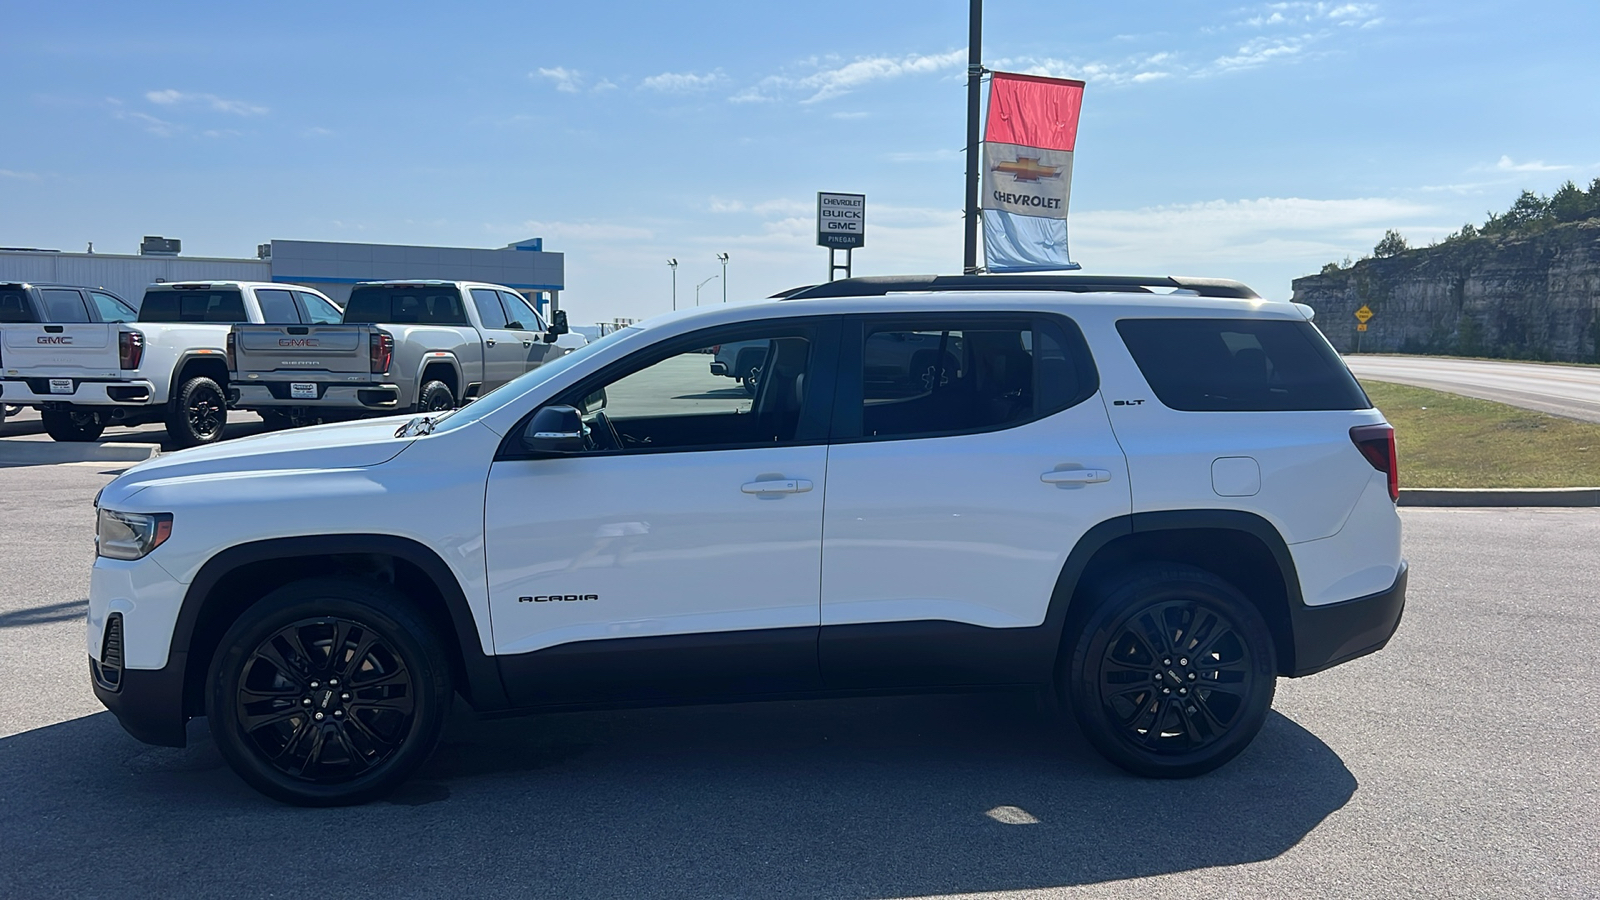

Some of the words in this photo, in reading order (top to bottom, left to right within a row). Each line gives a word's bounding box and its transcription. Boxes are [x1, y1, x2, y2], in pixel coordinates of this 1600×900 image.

[823, 198, 861, 206] CHEVROLET
[993, 190, 1061, 209] CHEVROLET
[822, 210, 861, 219] BUICK
[828, 222, 857, 230] GMC
[37, 336, 73, 344] GMC
[278, 338, 319, 347] GMC
[518, 594, 599, 603] ACADIA
